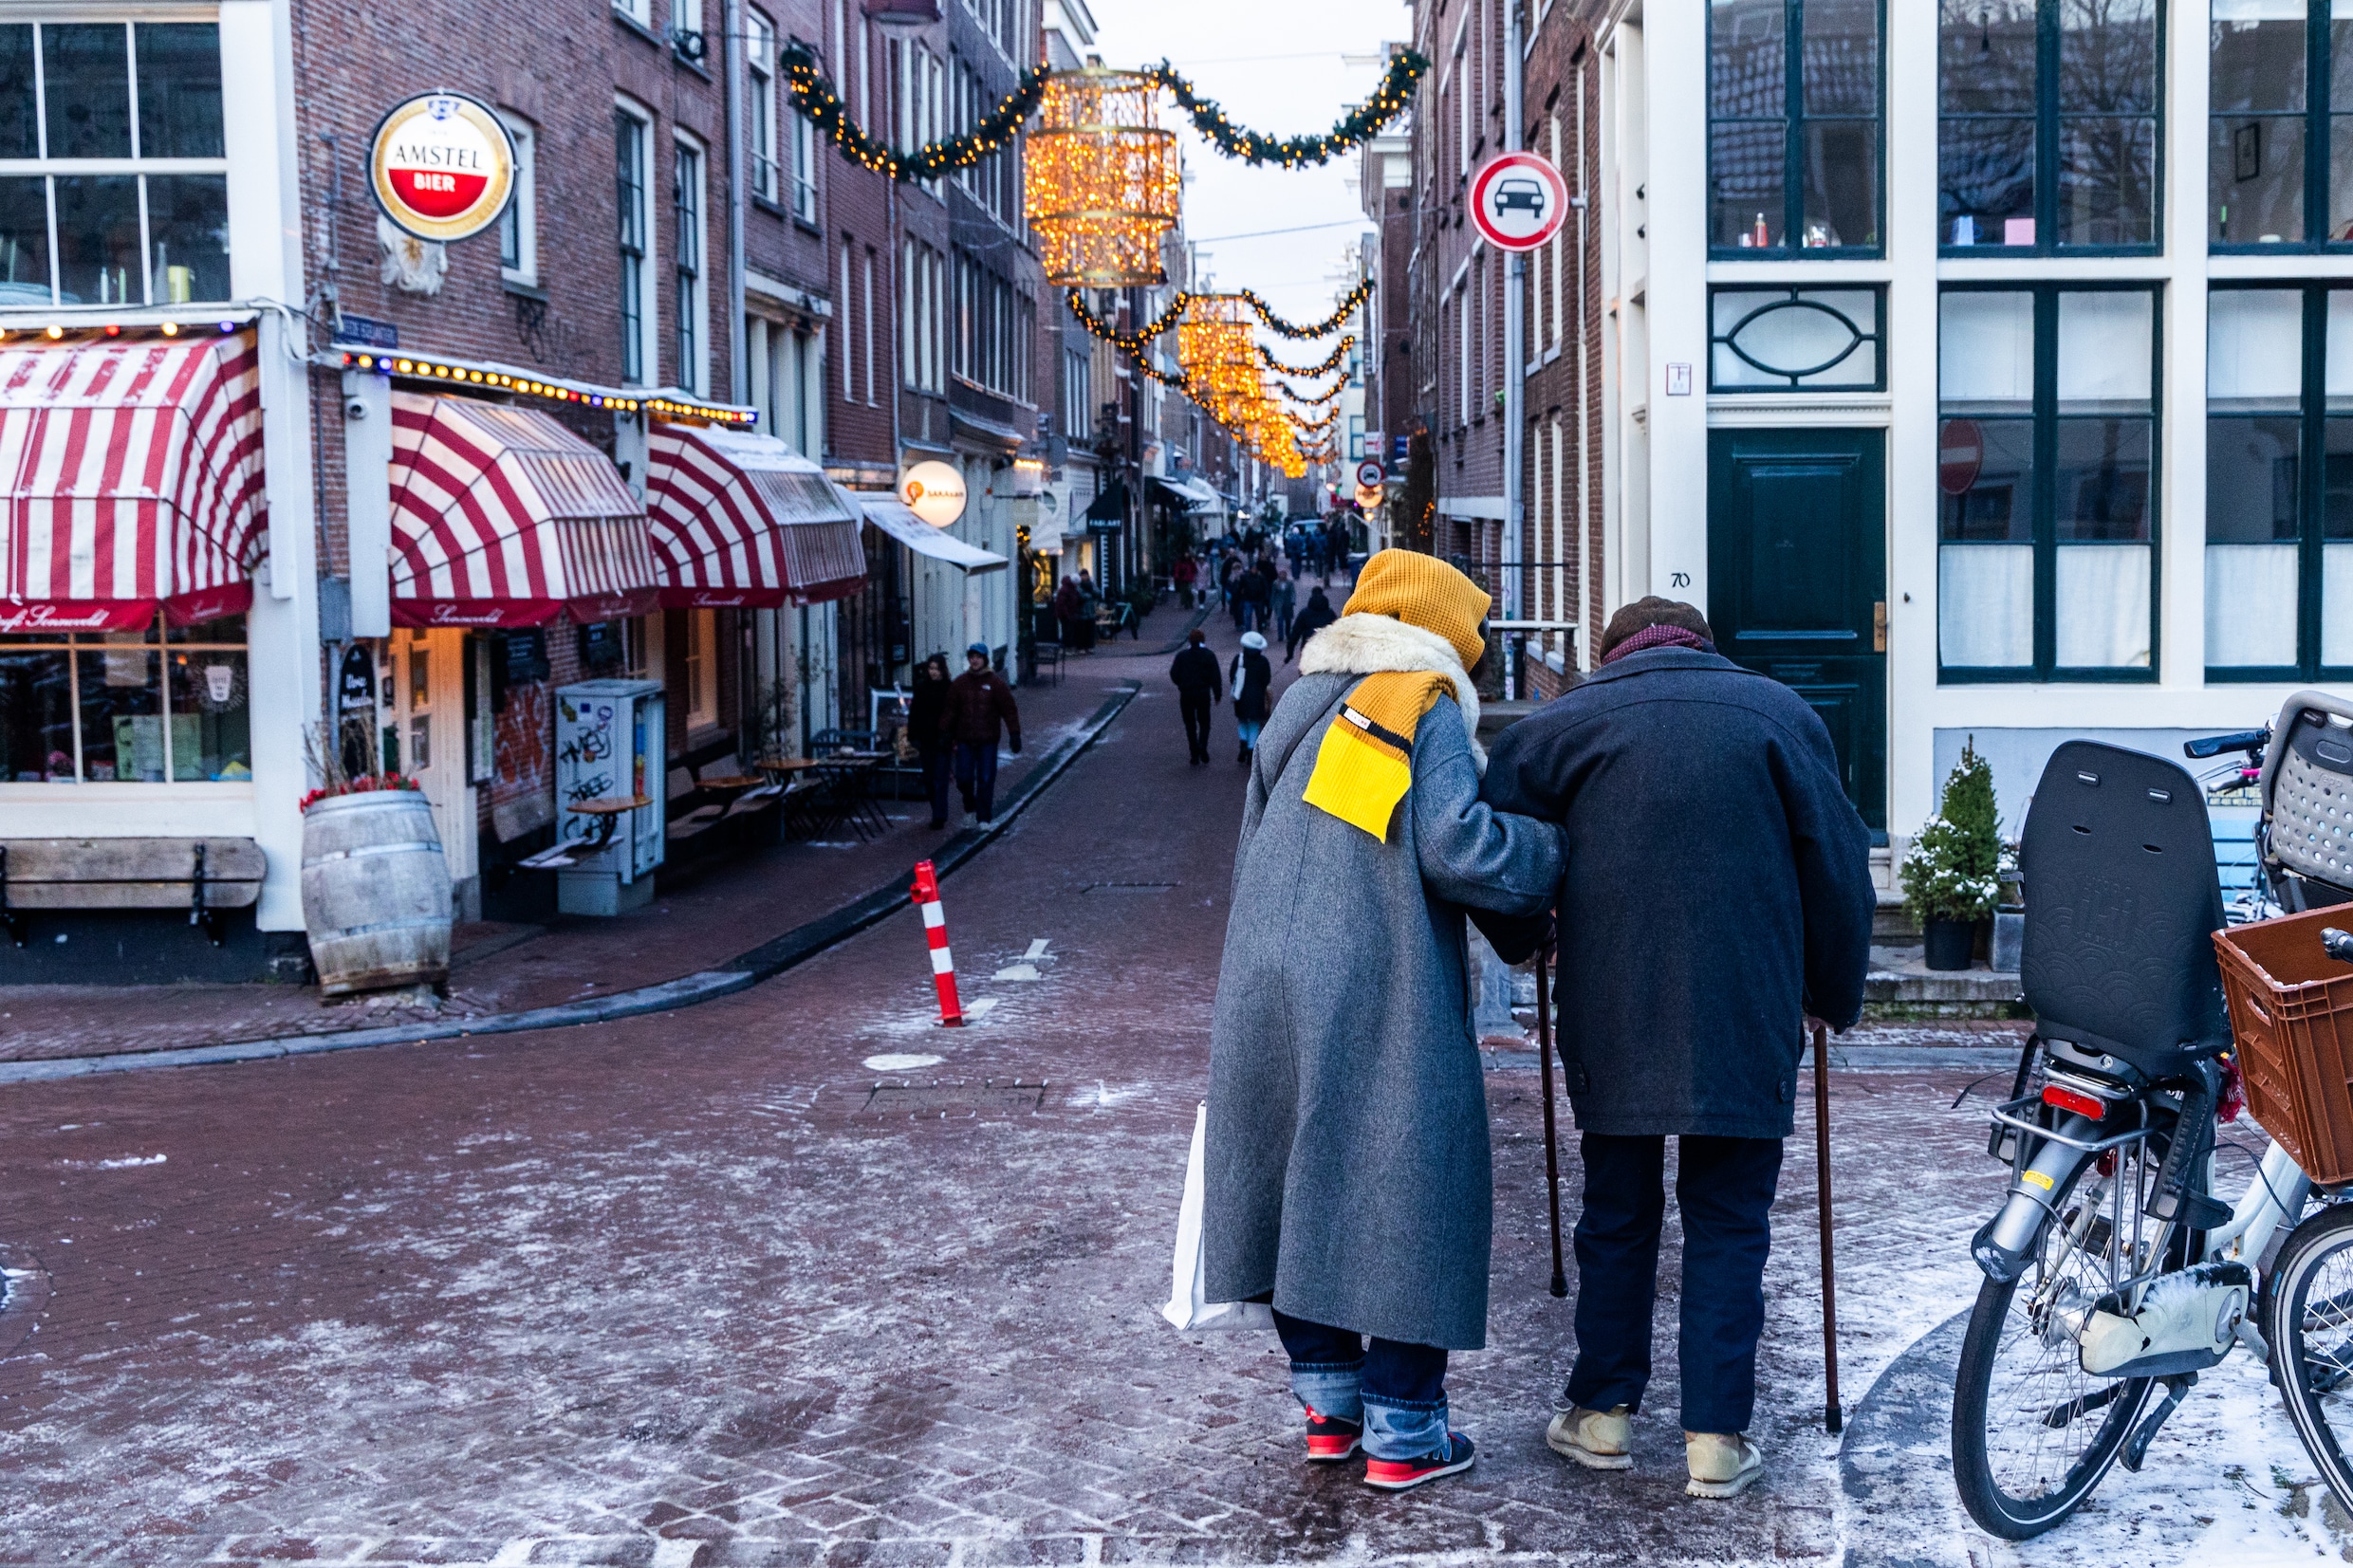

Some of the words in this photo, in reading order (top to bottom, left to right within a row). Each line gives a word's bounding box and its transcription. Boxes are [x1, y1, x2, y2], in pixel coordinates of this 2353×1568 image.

[394, 144, 482, 170] AMSTEL
[413, 172, 456, 193] BIER
[1671, 573, 1691, 588] 70
